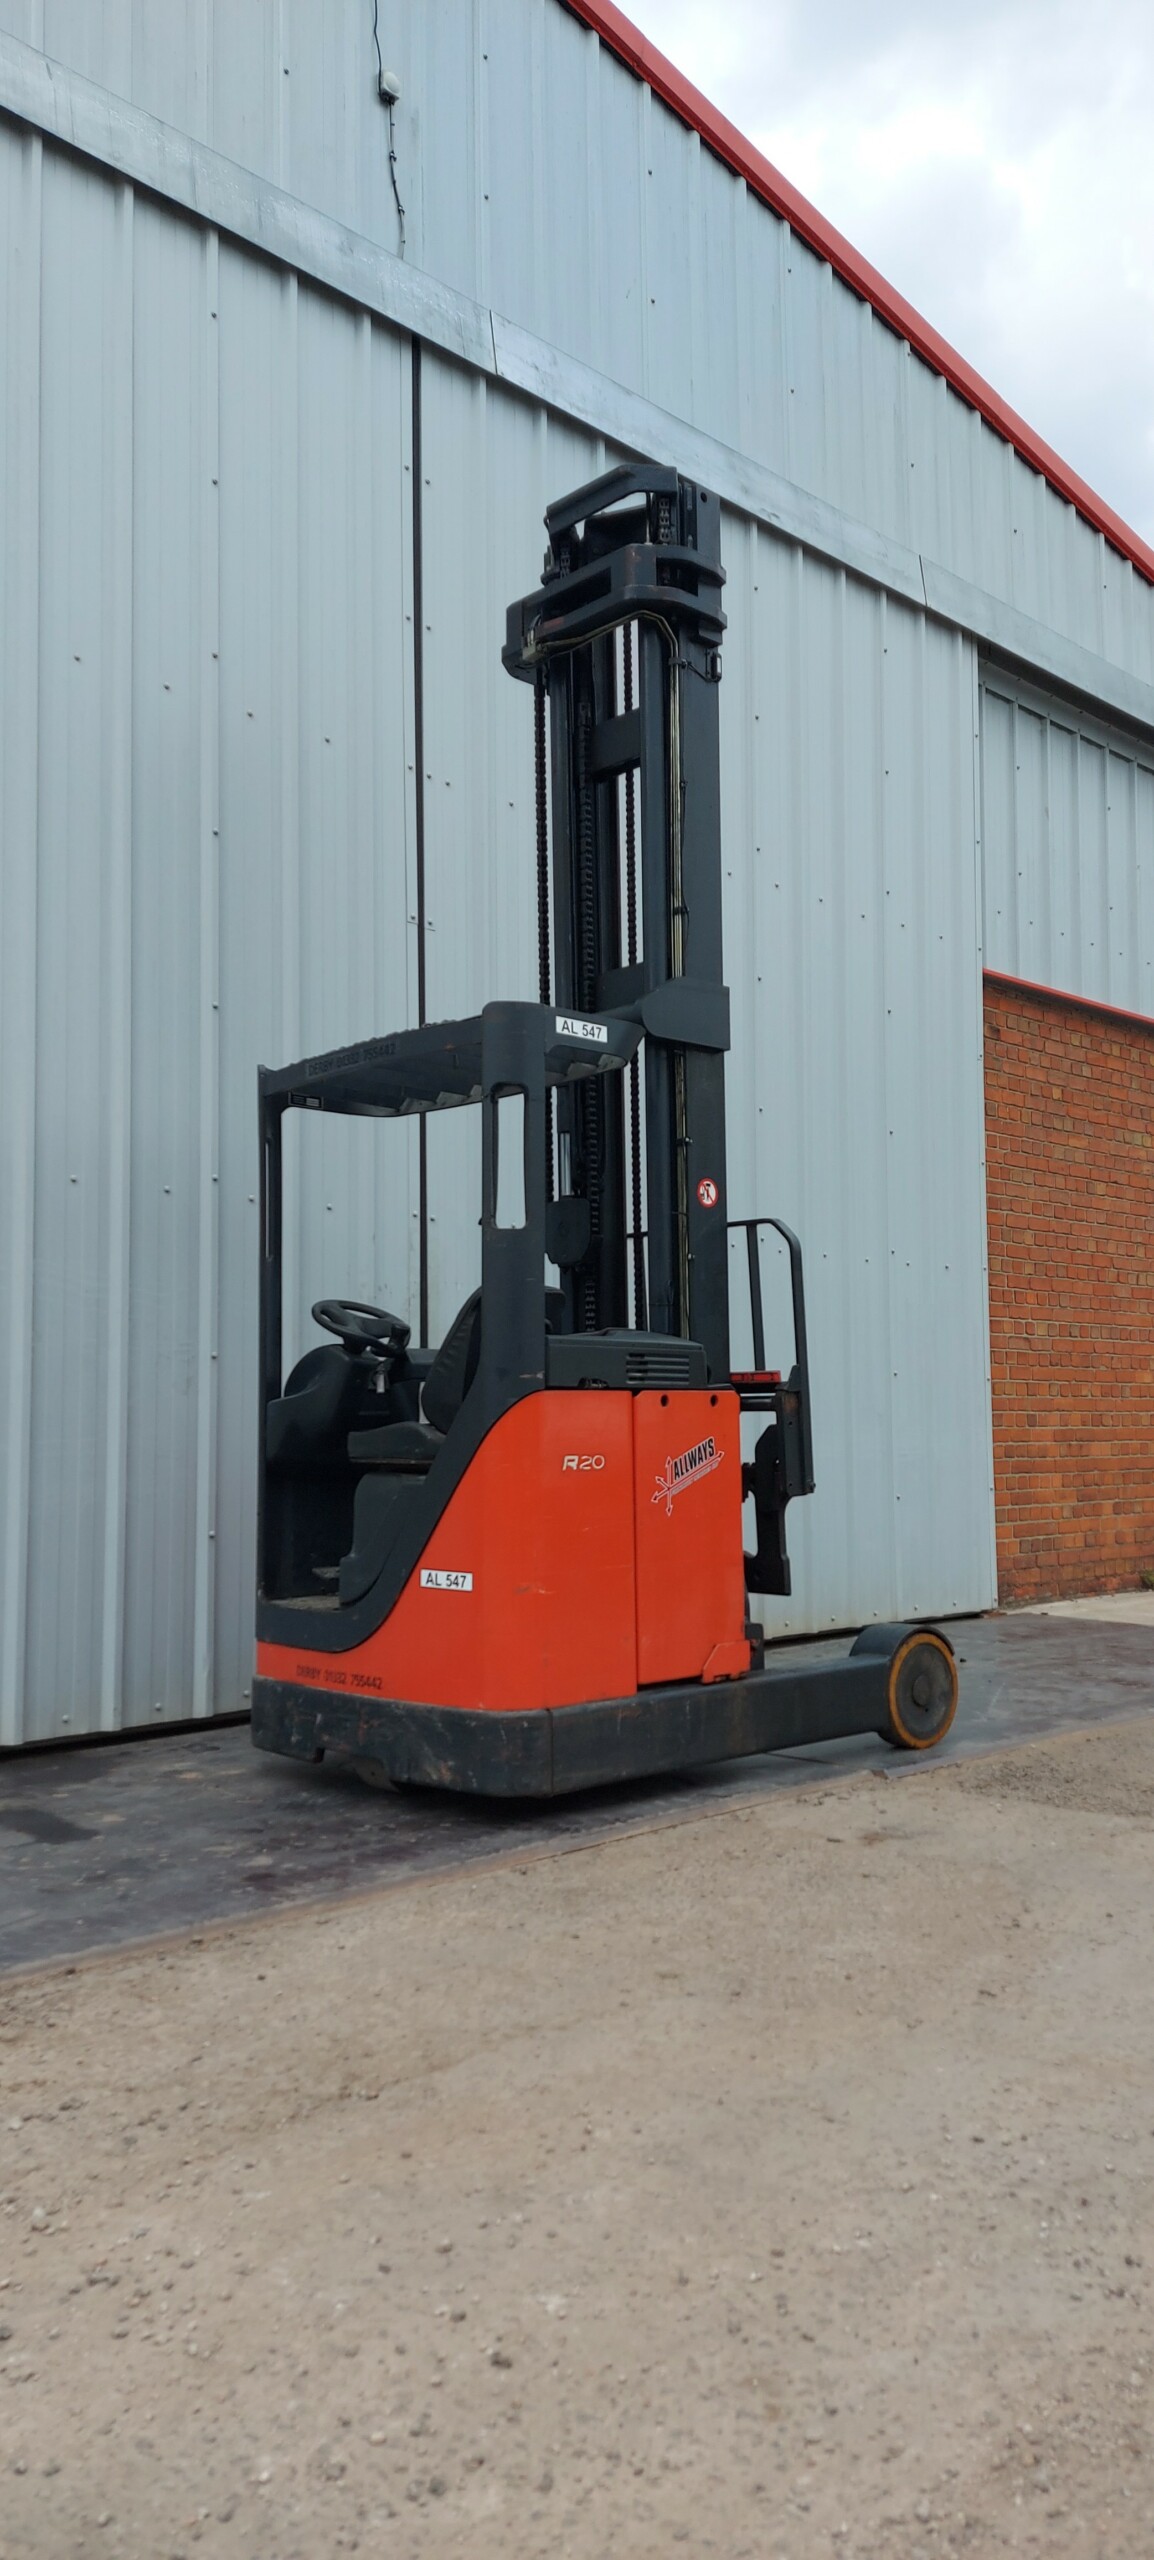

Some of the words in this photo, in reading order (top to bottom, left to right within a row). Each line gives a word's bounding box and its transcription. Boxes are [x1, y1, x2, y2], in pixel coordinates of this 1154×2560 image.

[561, 1019, 578, 1035] AL
[582, 1023, 602, 1040] 547
[562, 1454, 605, 1471] R20
[673, 1437, 715, 1481] ALLWAYS
[425, 1571, 442, 1586] AL
[446, 1573, 467, 1588] 547
